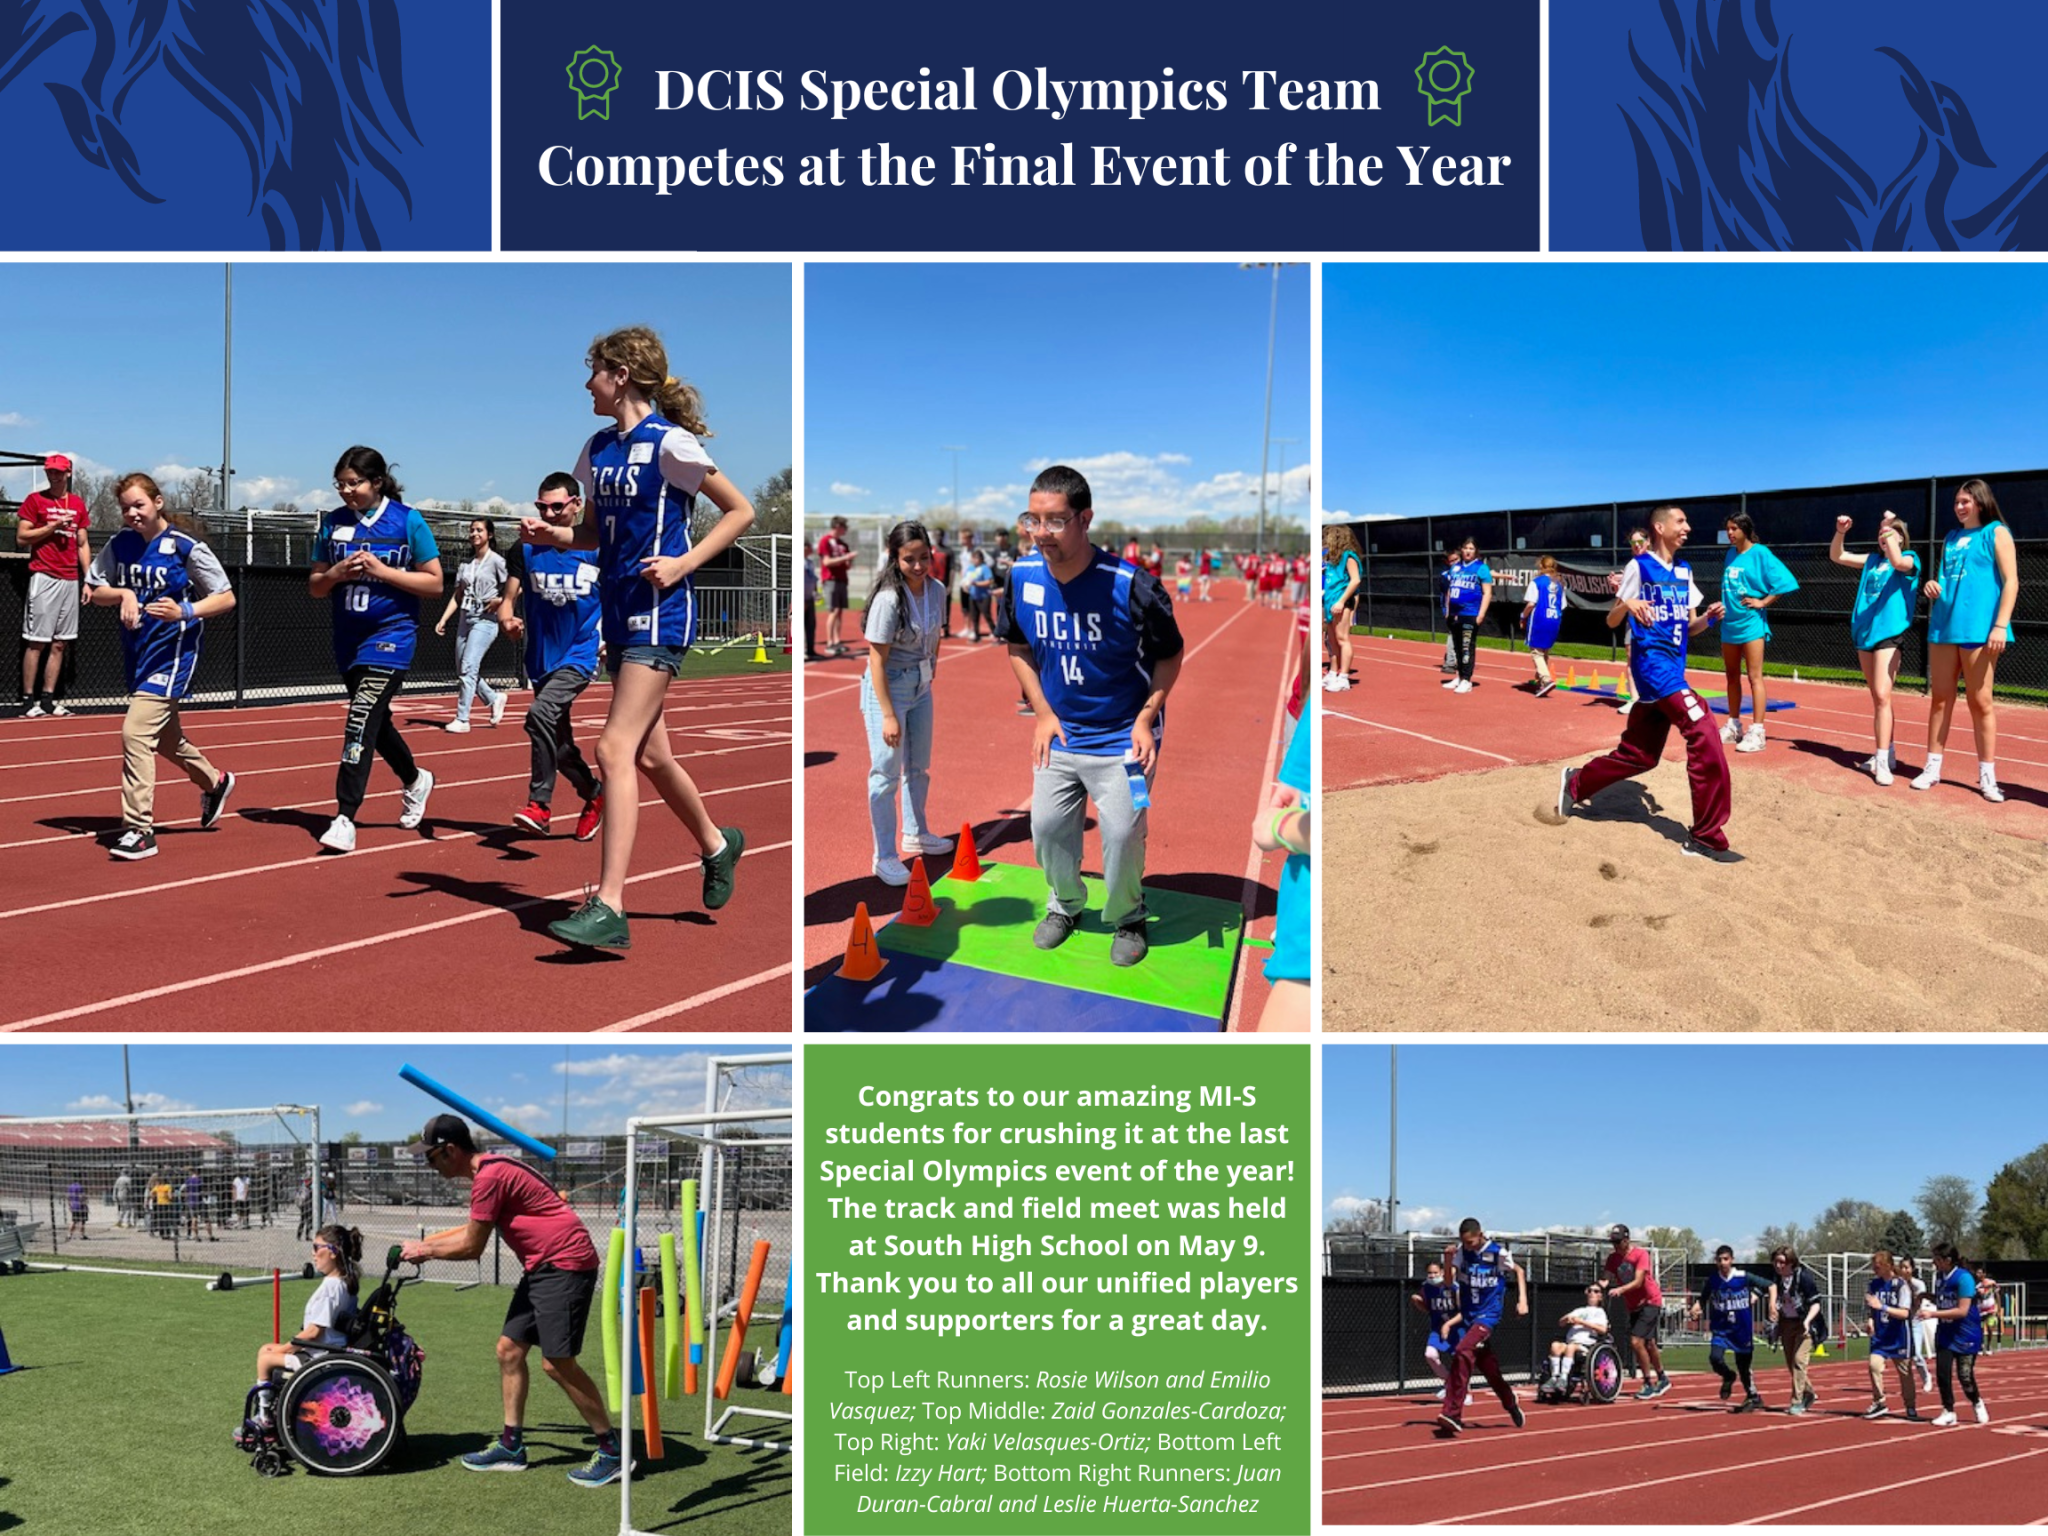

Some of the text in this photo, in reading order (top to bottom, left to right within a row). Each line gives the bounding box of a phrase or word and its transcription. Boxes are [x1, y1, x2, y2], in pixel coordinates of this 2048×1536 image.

[605, 515, 616, 546] 7
[344, 584, 371, 613] 10
[1034, 610, 1103, 642] DCIS
[1672, 624, 1682, 646] 5
[1061, 654, 1085, 686] 14
[907, 879, 926, 912] 5
[852, 926, 868, 955] 4
